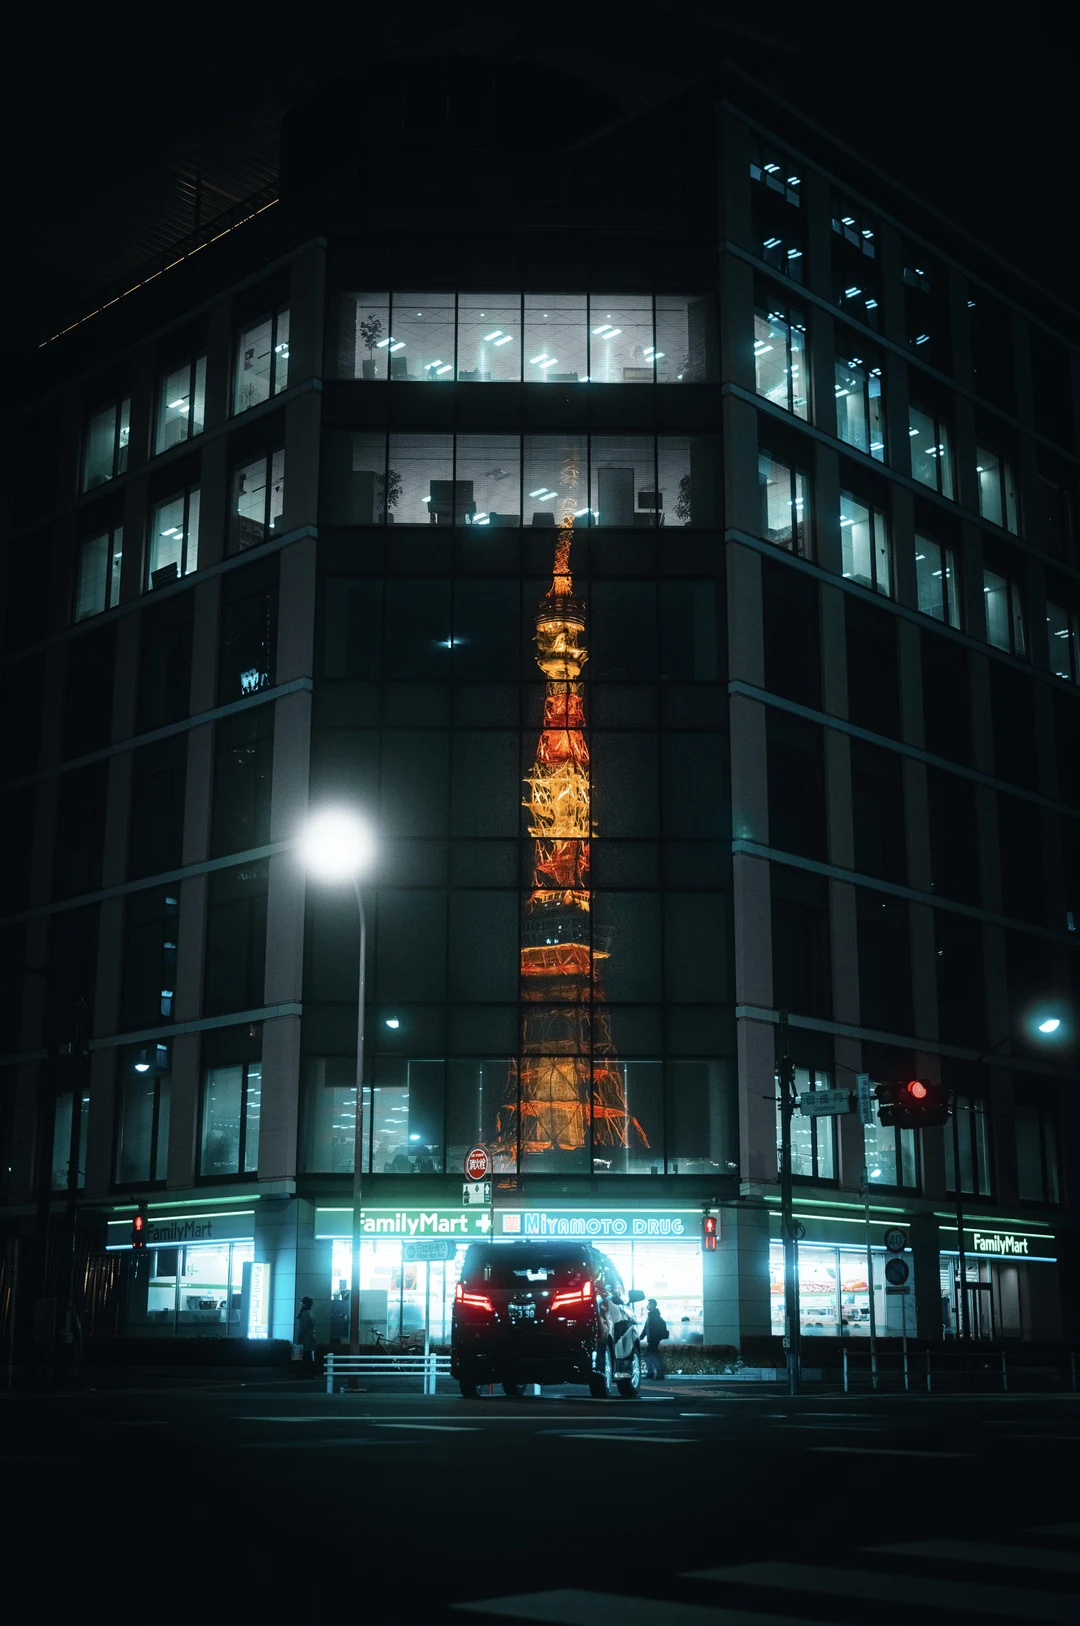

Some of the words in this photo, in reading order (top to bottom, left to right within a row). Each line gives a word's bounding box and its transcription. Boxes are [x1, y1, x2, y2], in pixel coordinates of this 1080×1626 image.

[469, 1158, 486, 1170] 消火栓
[148, 1220, 212, 1241] FamilyMart
[632, 1218, 684, 1234] DRUG
[974, 1233, 1028, 1255] FamilyMart
[252, 1266, 262, 1324] FamilyMart
